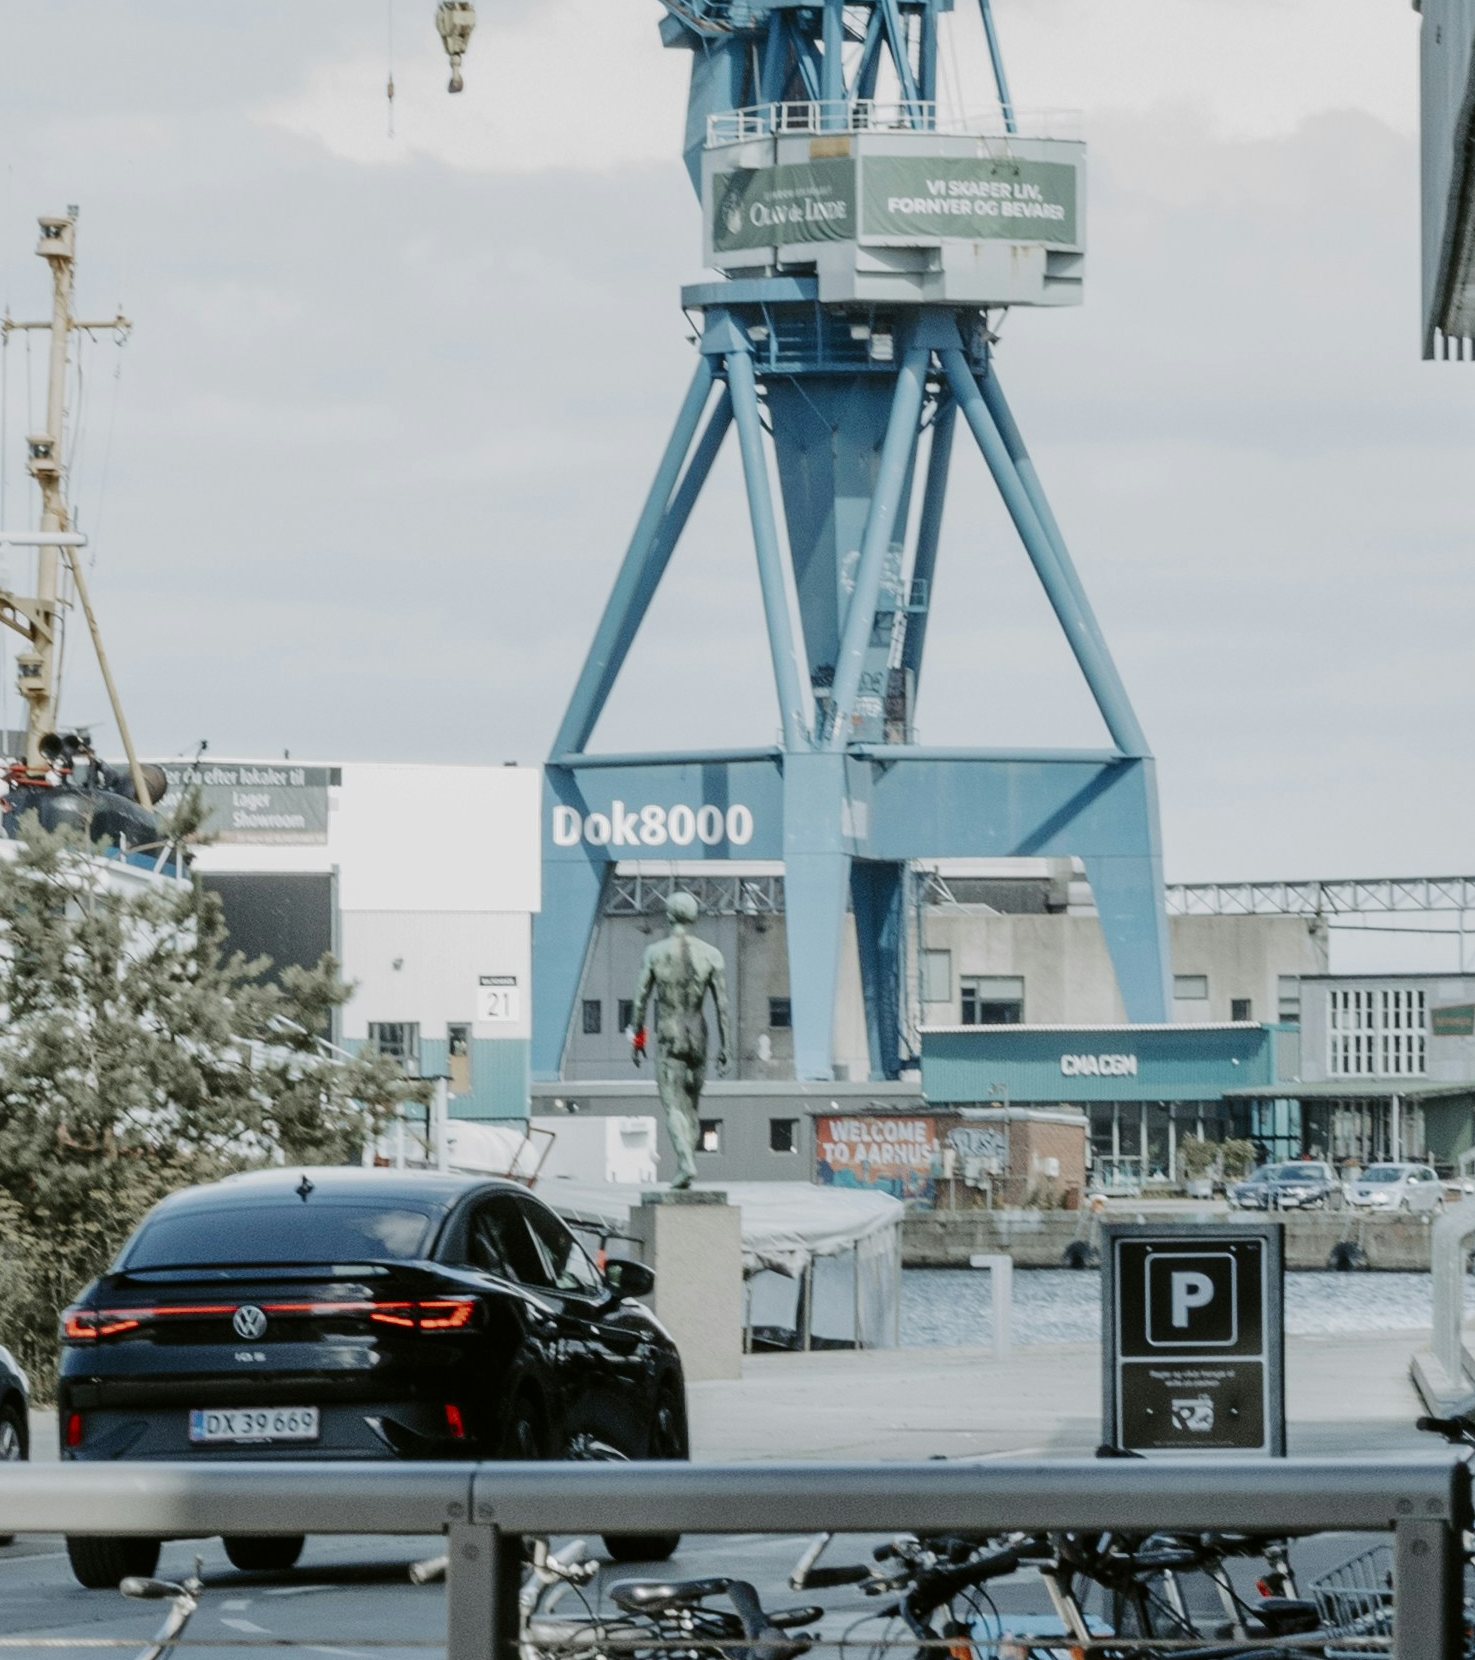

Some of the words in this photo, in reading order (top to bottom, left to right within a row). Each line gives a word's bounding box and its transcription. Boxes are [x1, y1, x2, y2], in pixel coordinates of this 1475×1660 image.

[926, 180, 946, 195] VI
[948, 180, 1012, 199] SKABER
[888, 198, 972, 215] FORNYER
[974, 200, 998, 216] OG
[204, 767, 238, 786] efter
[240, 767, 287, 785] lokaler
[290, 768, 304, 786] til
[233, 792, 272, 811] Lager
[233, 810, 304, 828] Showroom
[552, 800, 753, 846] Dok8000
[487, 992, 509, 1017] 21
[829, 1120, 928, 1143] WELCOME
[822, 1142, 850, 1163] TO
[1171, 1271, 1214, 1328] P
[207, 1415, 235, 1434] DX
[242, 1413, 268, 1433] 39
[274, 1412, 313, 1432] 669
